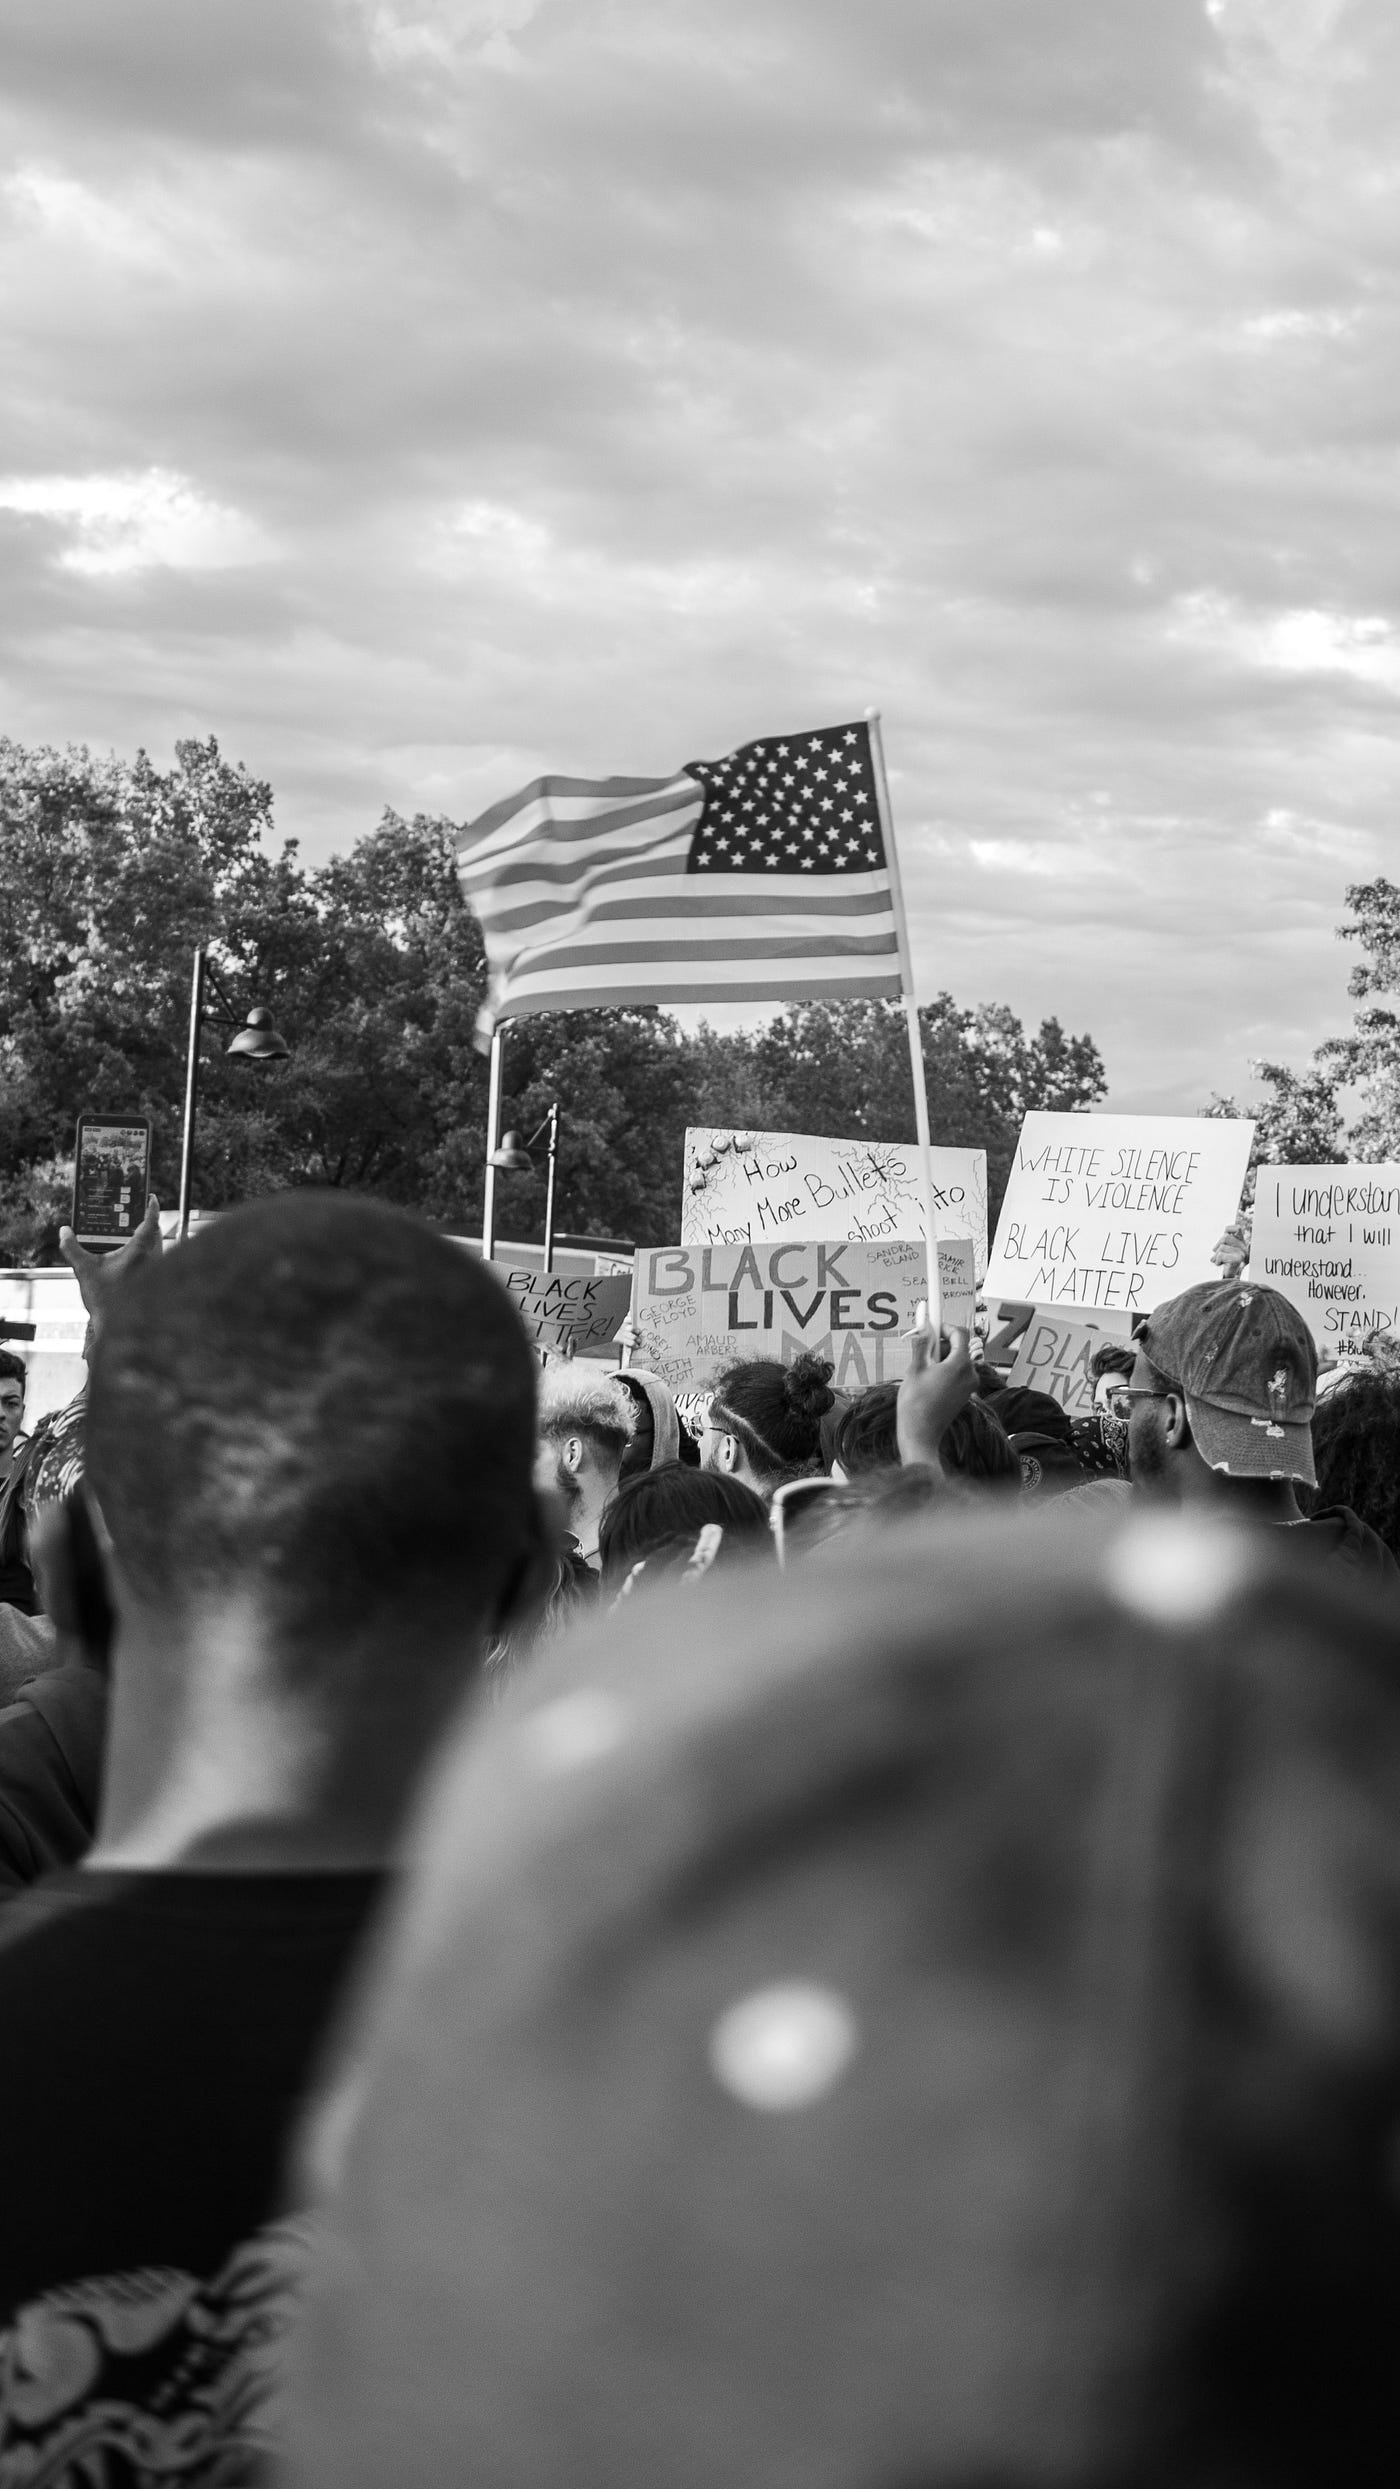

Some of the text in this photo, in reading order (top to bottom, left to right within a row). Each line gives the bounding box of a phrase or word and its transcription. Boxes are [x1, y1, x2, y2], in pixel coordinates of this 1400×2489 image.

[743, 1155, 798, 1186] How
[1019, 1145, 1201, 1184] WHITE SILENCE
[707, 1153, 907, 1245] Many More Bullets
[1041, 1178, 1190, 1214] IS VIOLENCE
[1276, 1181, 1400, 1220] I understan
[847, 1205, 898, 1243] shoot
[915, 1182, 966, 1214] ito
[1003, 1222, 1183, 1269] BLACK LIVES
[1293, 1223, 1391, 1247] that I will
[866, 1243, 914, 1264] SANDRA
[882, 1250, 920, 1268] BLAND
[648, 1244, 851, 1296] BLACK
[902, 1276, 969, 1287] SEA BELL
[506, 1272, 603, 1301] BLACK
[942, 1290, 974, 1300] BROWN
[1025, 1267, 1145, 1308] MATTER
[519, 1296, 597, 1321] LIVES
[639, 1293, 698, 1322] GEORGE
[652, 1306, 698, 1329] FLOYD
[728, 1289, 899, 1331] LIVES
[530, 1316, 615, 1345] TTER!
[781, 1329, 912, 1386] MAT
[1026, 1326, 1122, 1374] BLA
[649, 1358, 692, 1375] KIETH
[661, 1368, 695, 1388] SCOTT
